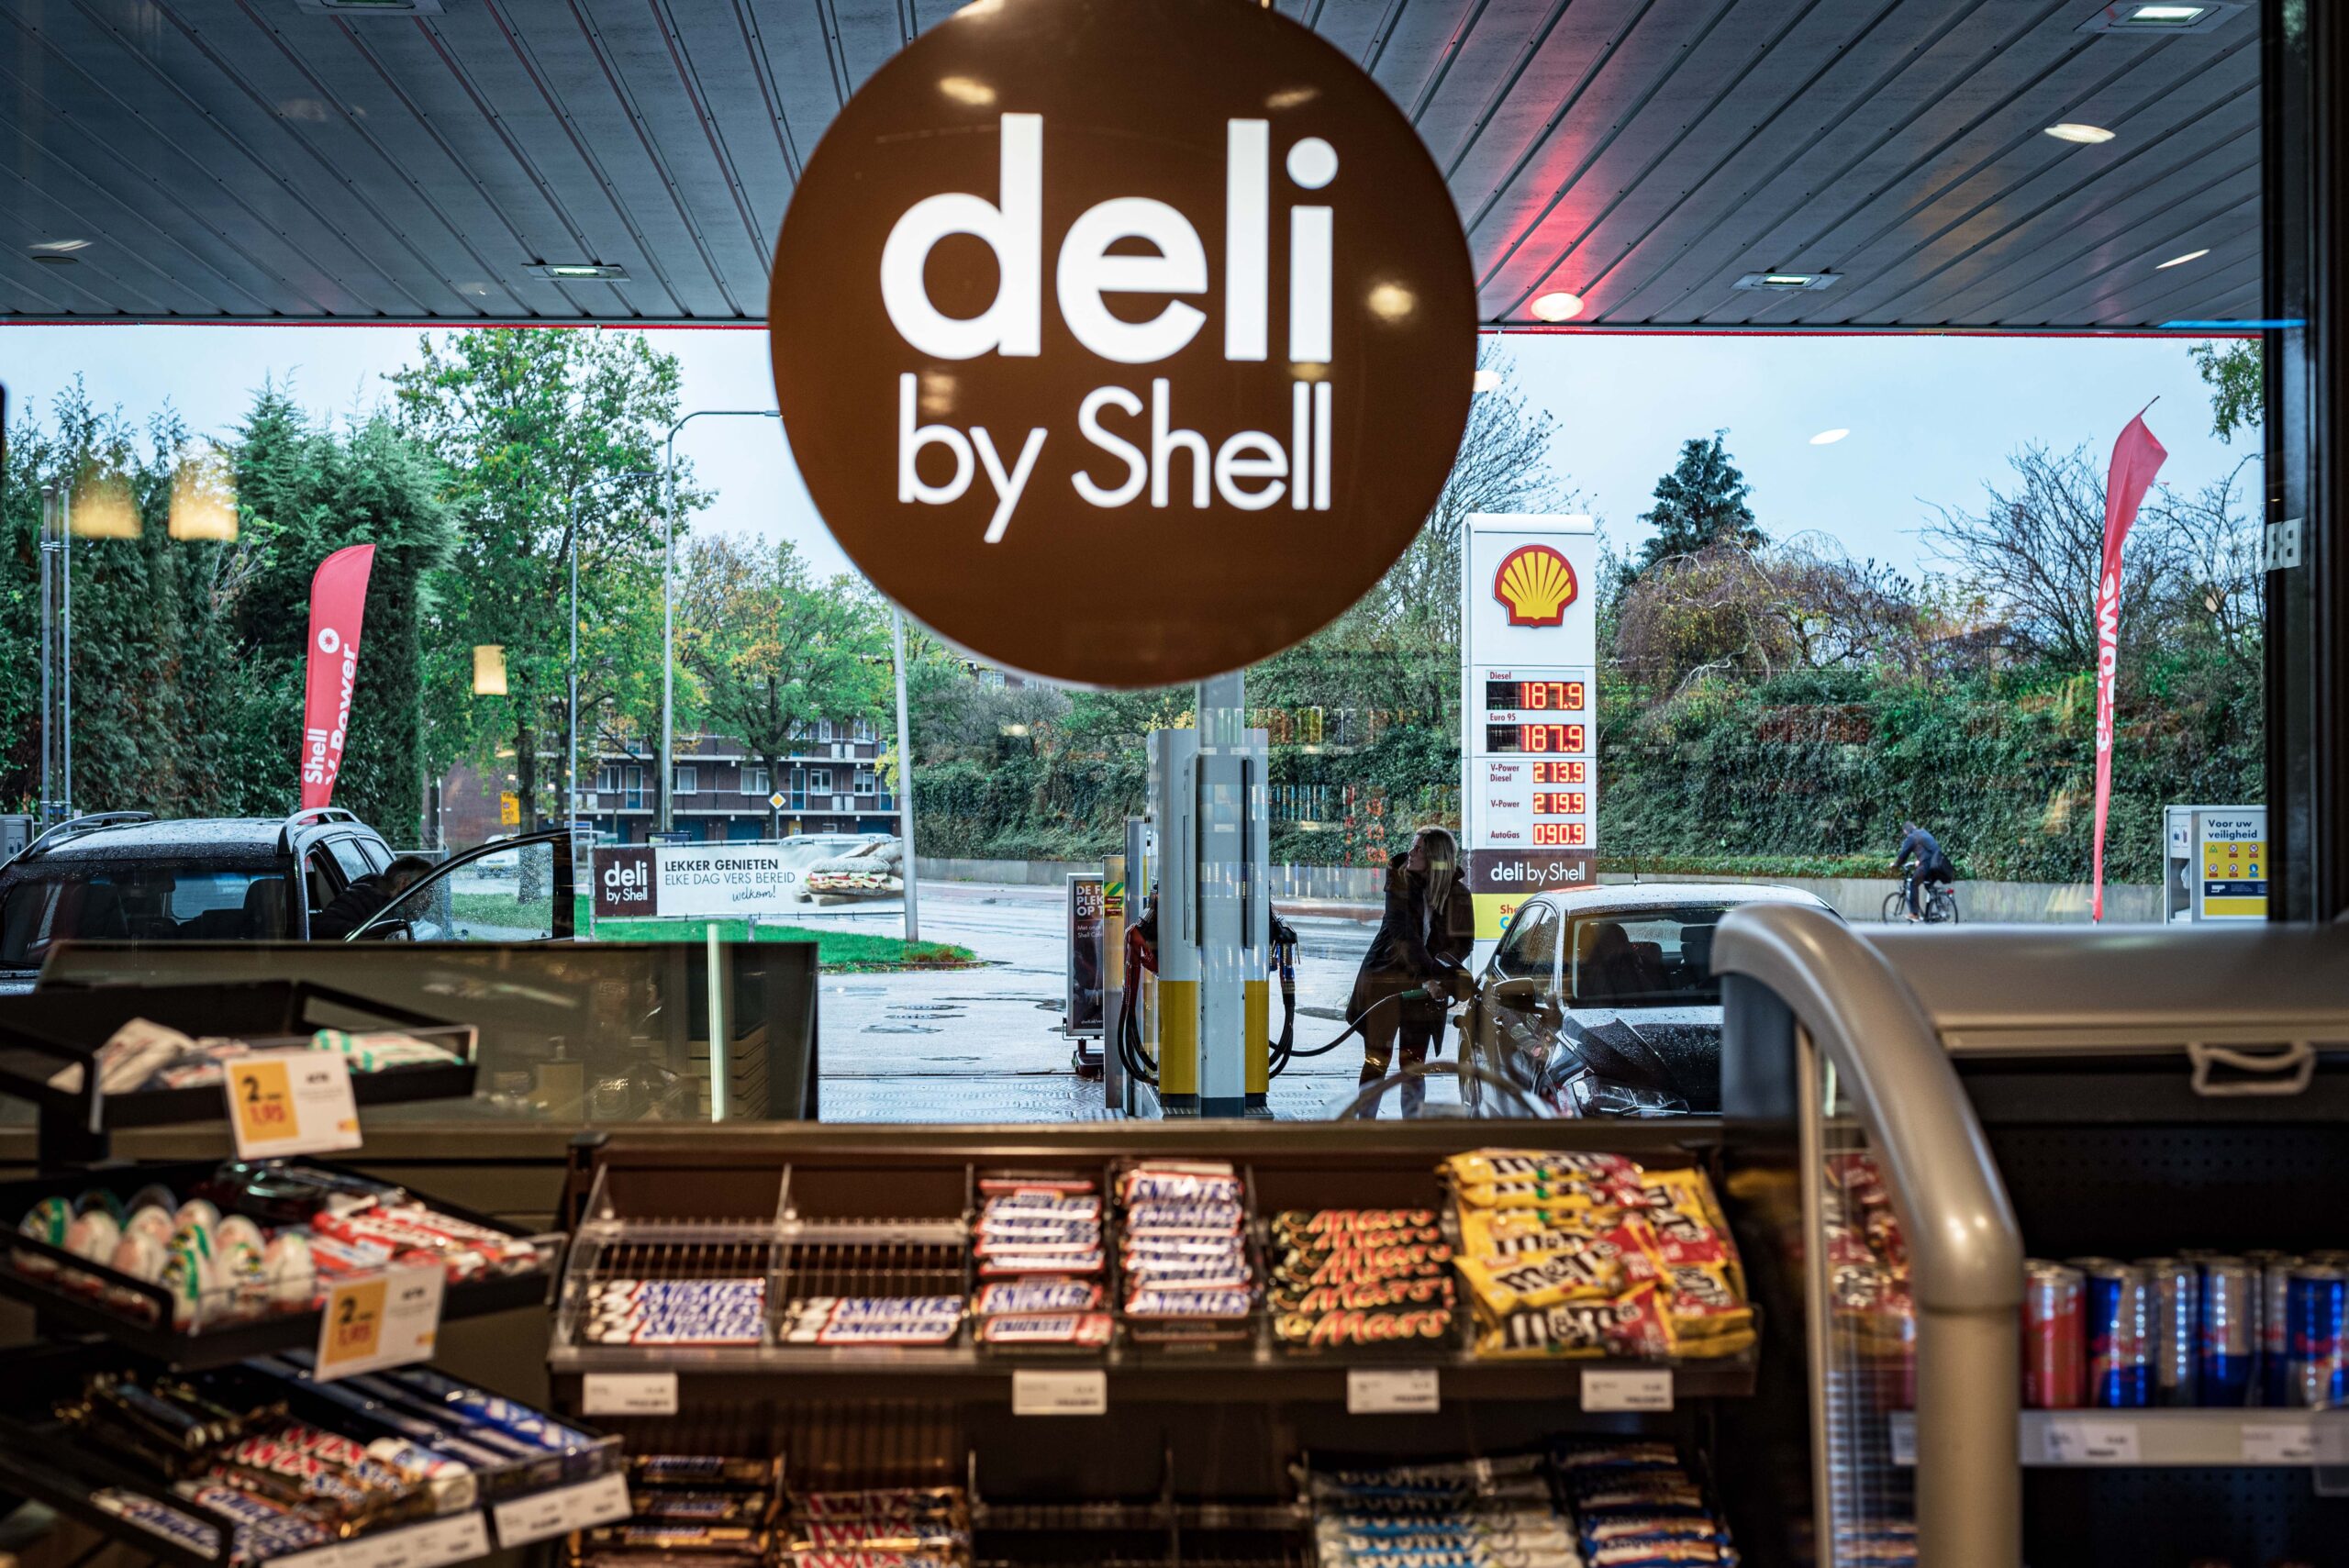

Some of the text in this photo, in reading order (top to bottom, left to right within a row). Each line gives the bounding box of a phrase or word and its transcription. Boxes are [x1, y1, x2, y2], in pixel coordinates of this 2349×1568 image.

[880, 112, 1339, 363] deli
[898, 373, 1332, 543] by Shell
[1489, 672, 1511, 680] Diesel
[1507, 713, 1516, 721] 95
[304, 728, 328, 784] Shell
[1490, 773, 1512, 782] Diesel
[1490, 799, 1520, 807] V-Power
[2208, 819, 2233, 828] Voor
[1490, 830, 1520, 839] AutoGas
[2208, 829, 2258, 840] veiligheid
[665, 859, 778, 872] LEKKER GENIETEN
[604, 861, 648, 886] deli
[665, 873, 796, 885] ELKE DAG VERS BEREID
[1490, 862, 1586, 886] deli by Shell
[607, 887, 648, 905] by Shell
[732, 884, 776, 902] welkom!
[1076, 885, 1091, 895] DE
[1076, 895, 1104, 906] PLEK
[1076, 906, 1095, 917] OP
[1499, 916, 1510, 929] C
[1308, 1308, 1452, 1346] Mars
